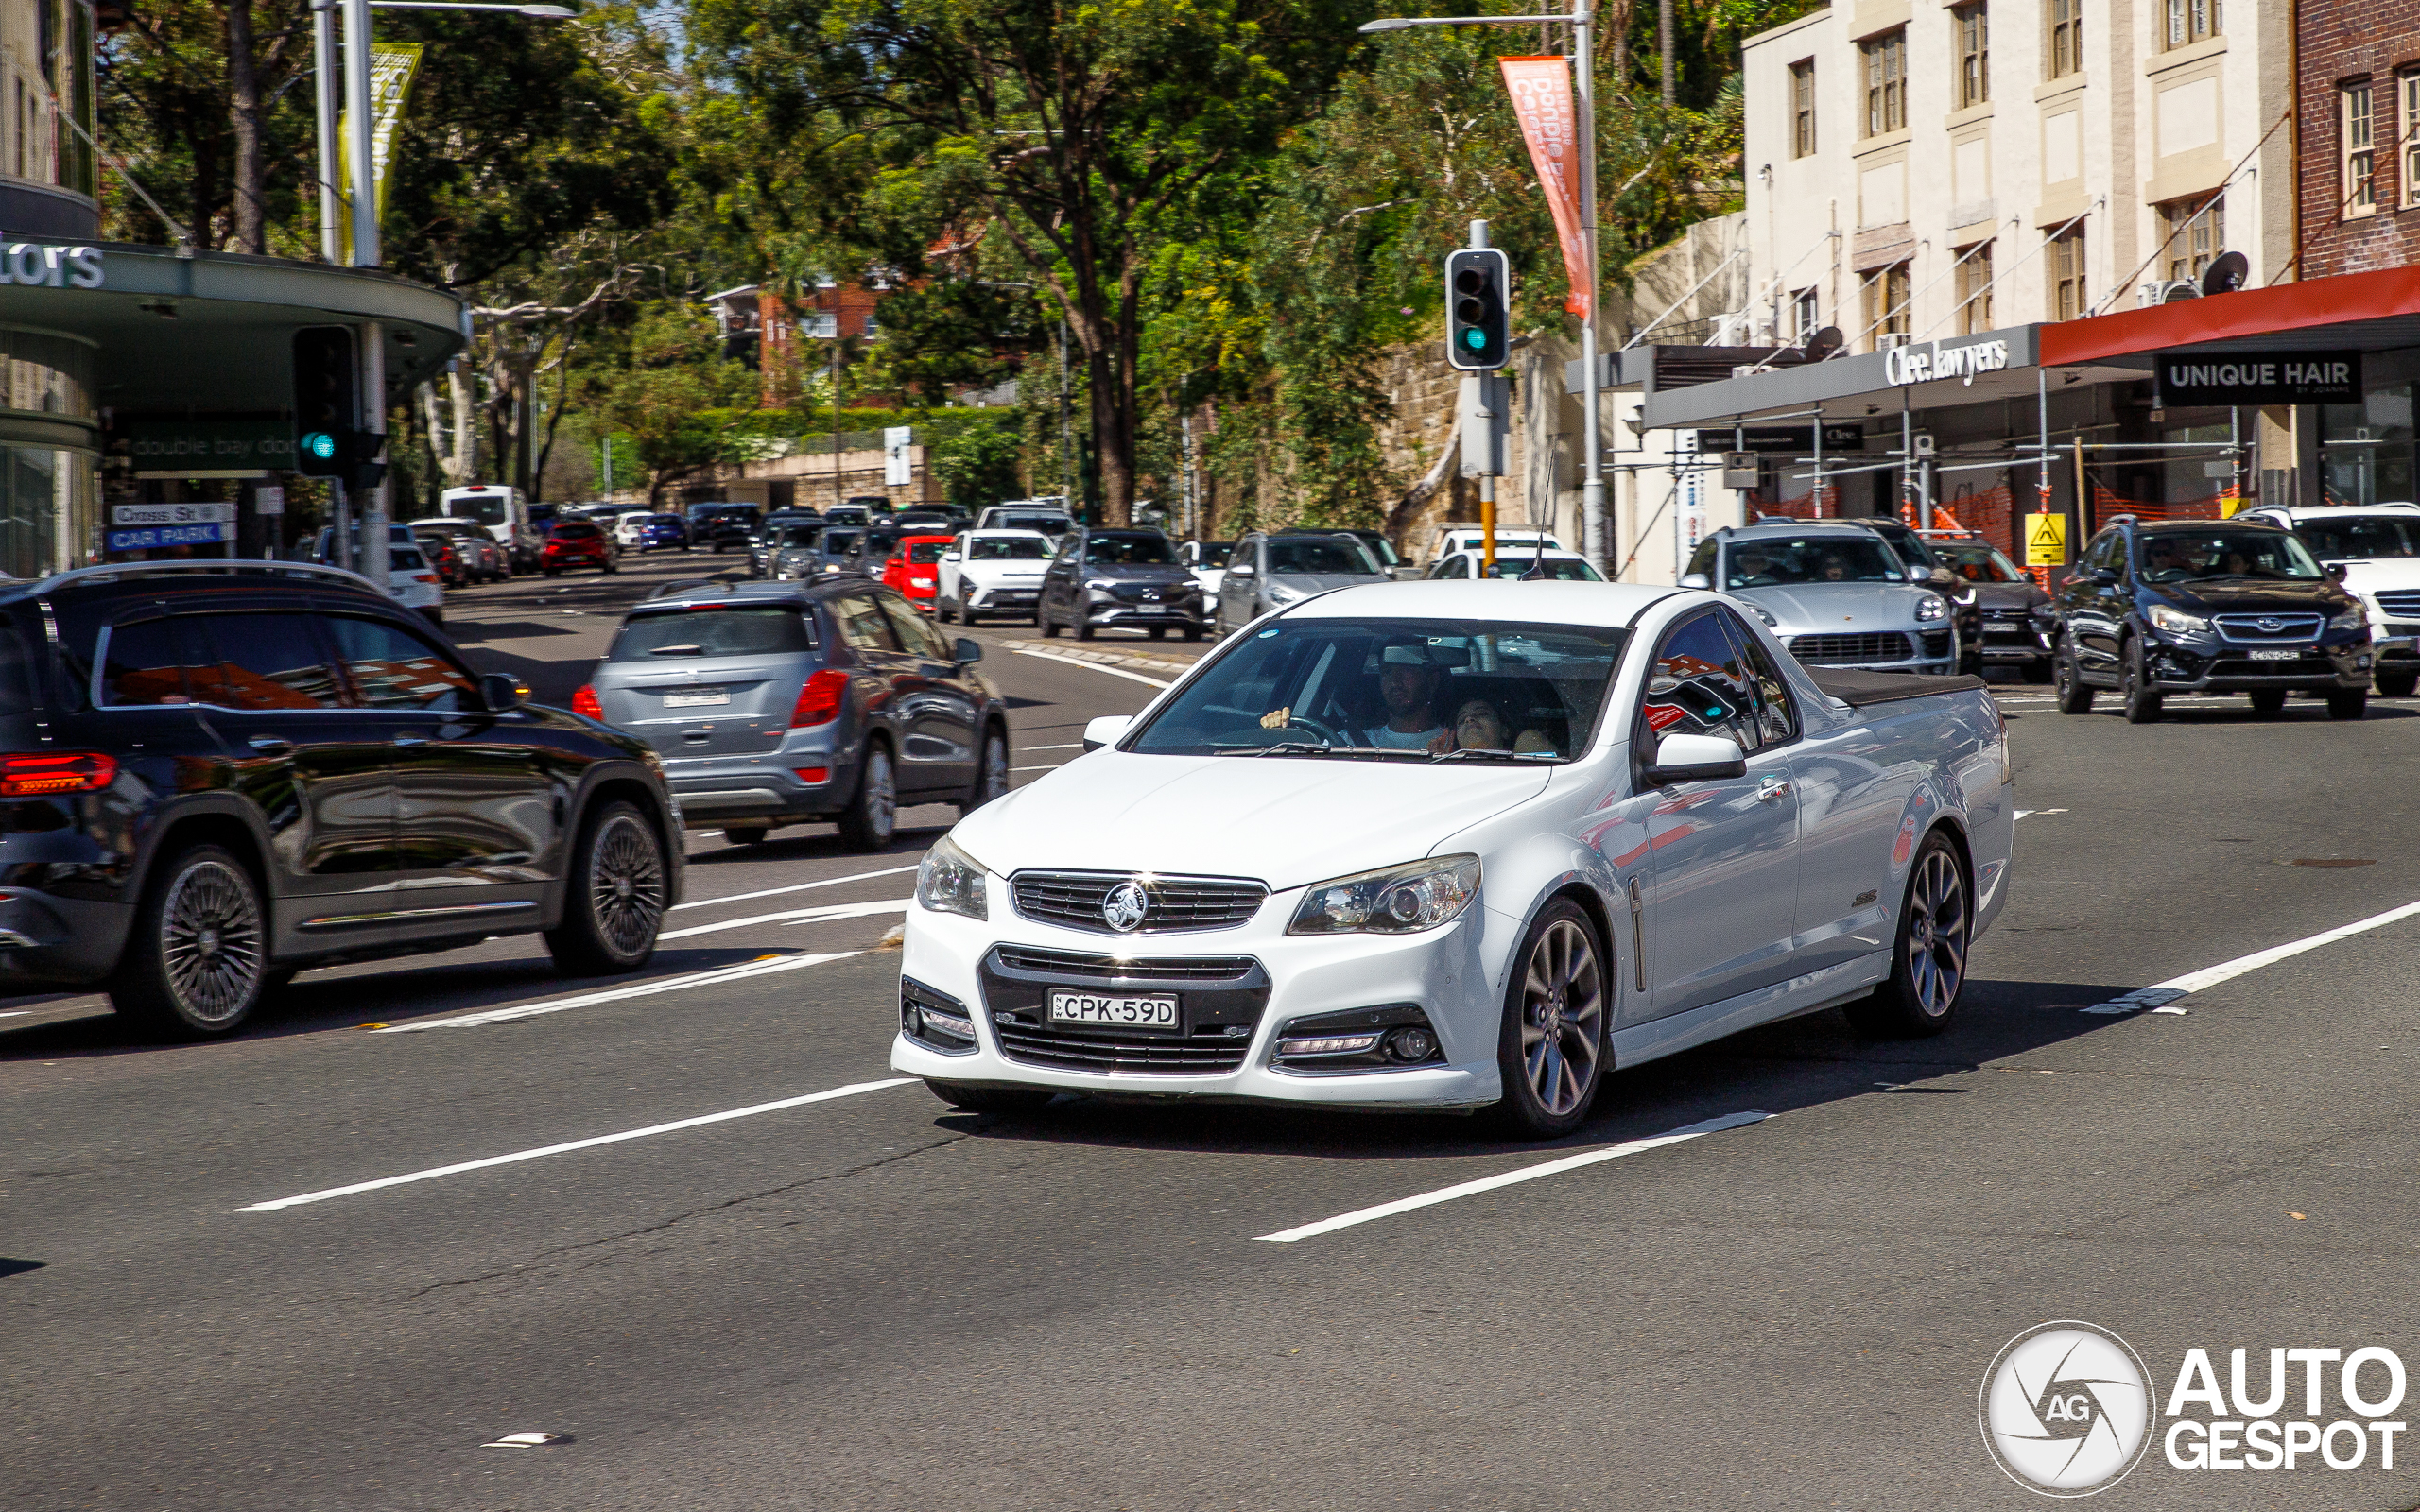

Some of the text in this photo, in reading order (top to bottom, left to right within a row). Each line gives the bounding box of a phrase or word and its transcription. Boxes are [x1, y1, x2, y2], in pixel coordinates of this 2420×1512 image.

[2170, 362, 2350, 387] UNIQUE HAIR
[117, 507, 196, 522] Cross St
[113, 526, 216, 548] CAR PARK
